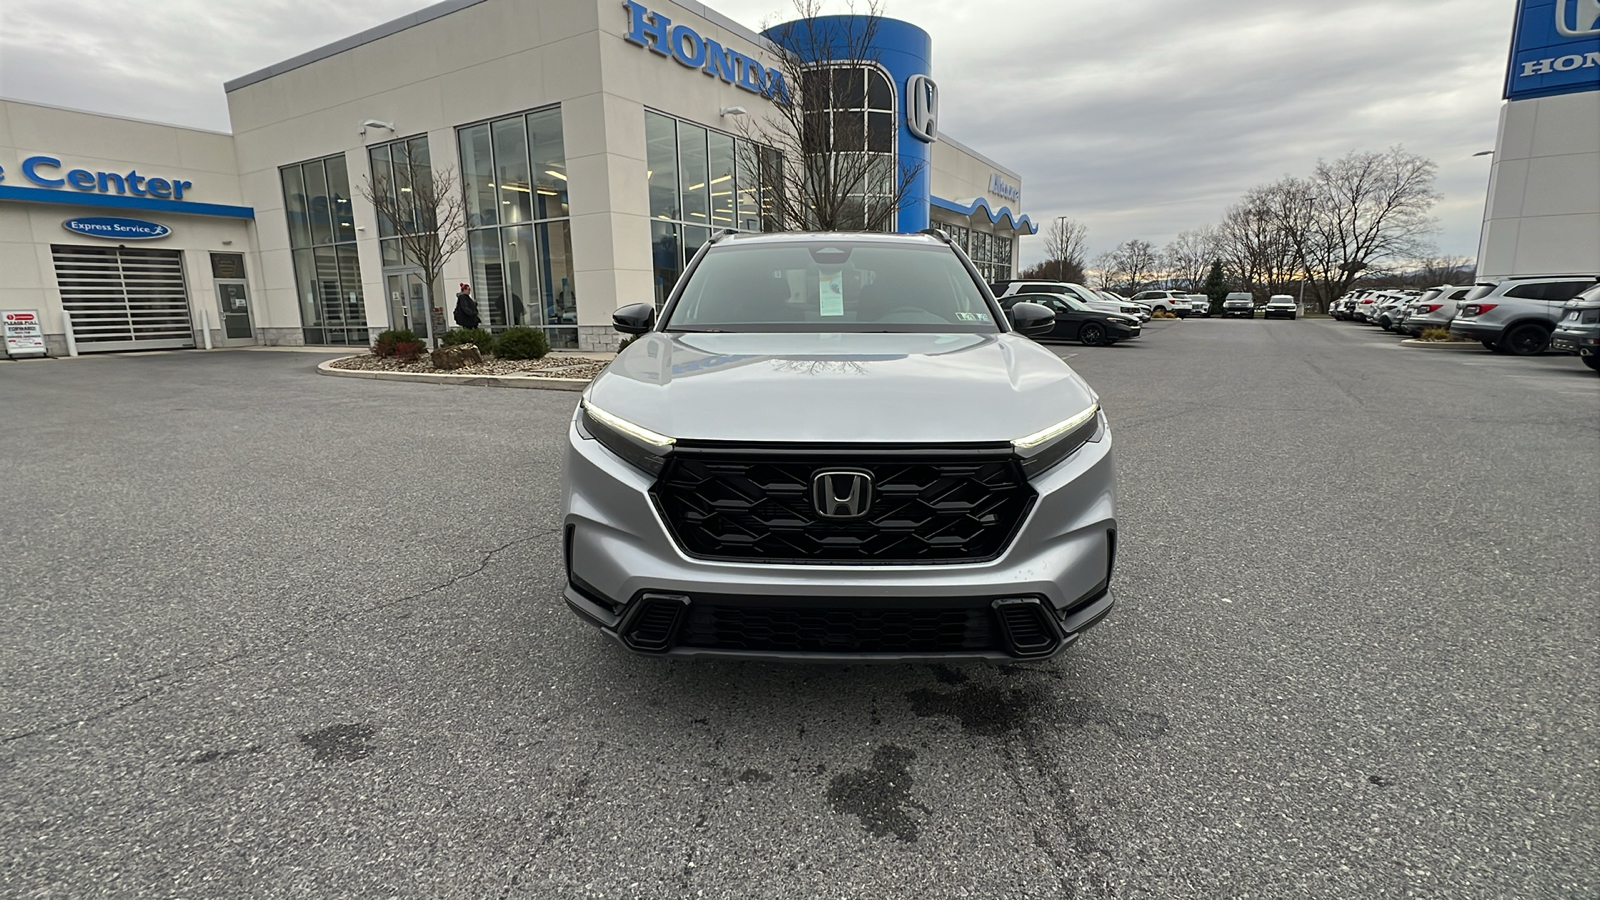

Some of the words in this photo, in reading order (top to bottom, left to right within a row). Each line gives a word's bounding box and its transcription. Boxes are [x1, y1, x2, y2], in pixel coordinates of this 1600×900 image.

[622, 0, 794, 105] HONDA
[22, 155, 192, 200] Center
[71, 221, 112, 231] Express
[114, 224, 151, 233] Service
